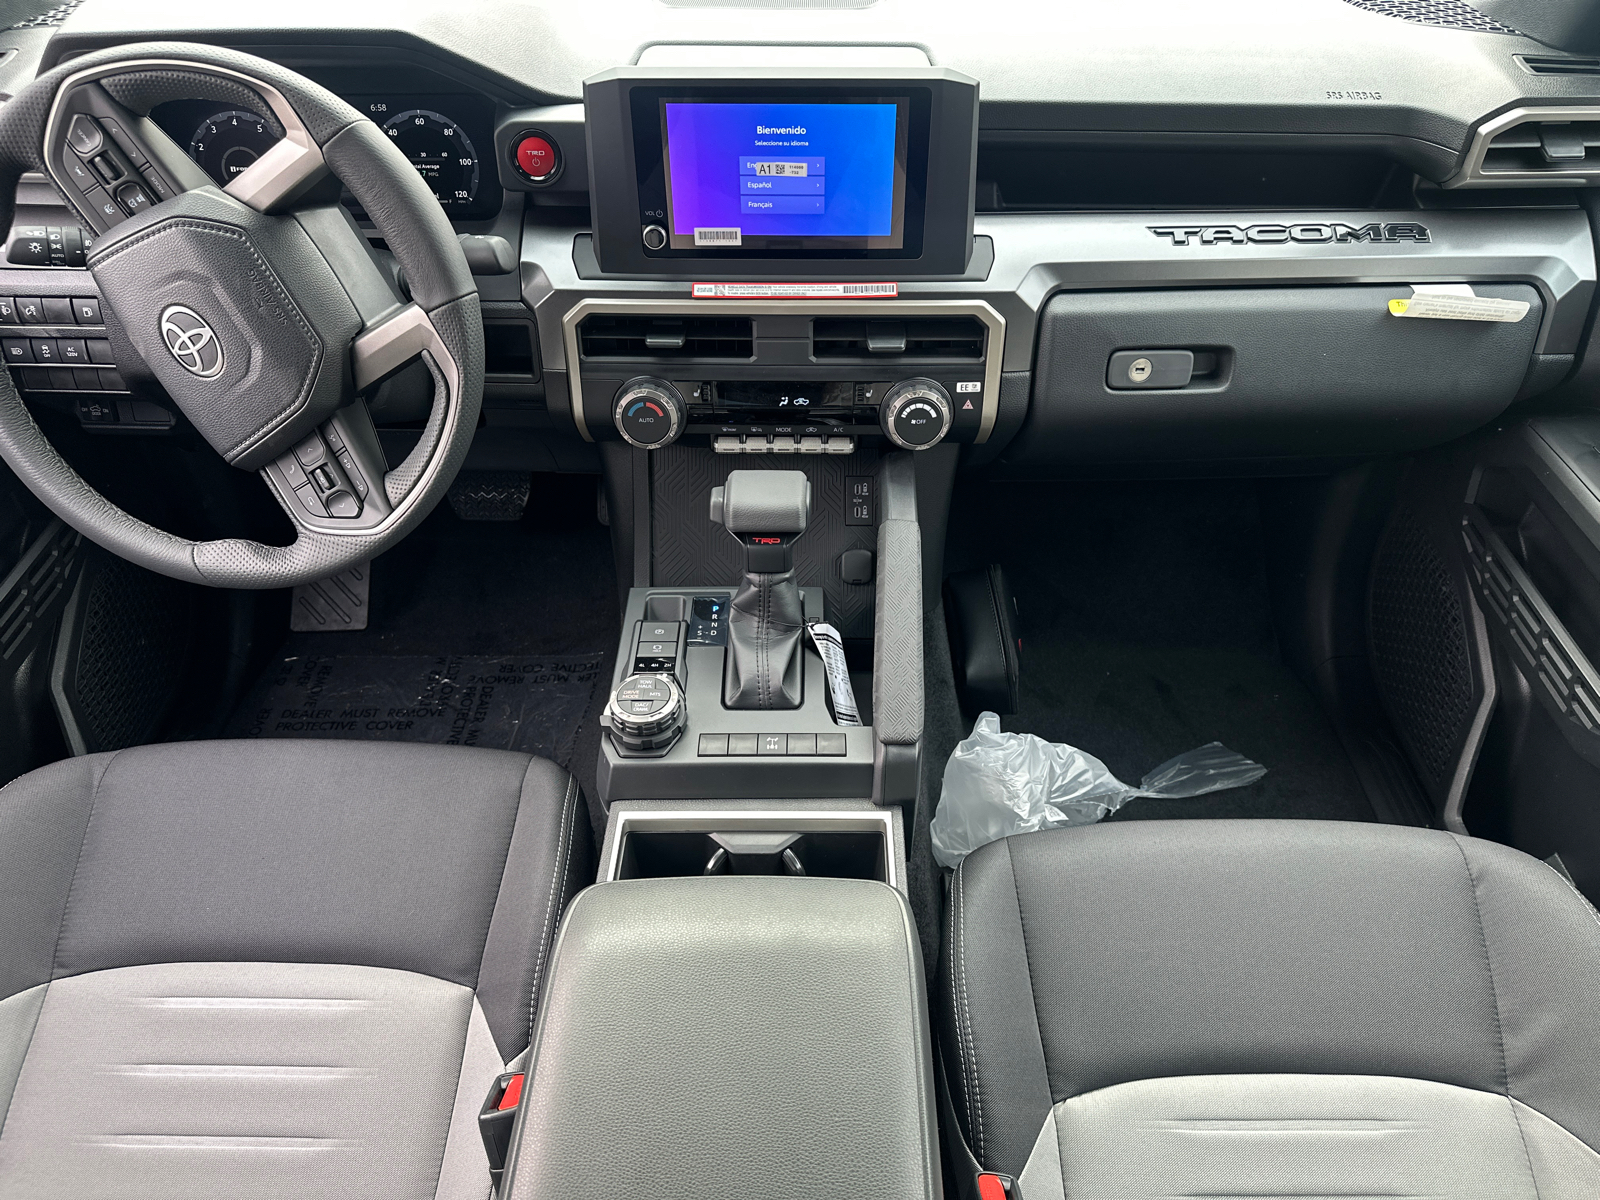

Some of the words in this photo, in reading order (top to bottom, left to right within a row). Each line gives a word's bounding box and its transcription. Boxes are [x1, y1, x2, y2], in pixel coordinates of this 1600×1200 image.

[1326, 91, 1343, 100] SRS
[1346, 91, 1382, 100] AIRBAG
[370, 104, 387, 112] 6:58
[232, 118, 237, 126] 4
[415, 118, 425, 126] 60
[211, 126, 217, 134] 3
[257, 124, 263, 133] 5
[388, 128, 398, 136] 40
[444, 128, 453, 136] 80
[756, 125, 807, 135] Bienvenido
[198, 143, 204, 151] 2
[459, 158, 472, 166] 100
[759, 164, 771, 175] A1
[747, 181, 772, 189] Español
[455, 190, 468, 198] 120
[748, 201, 773, 209] Français
[1145, 222, 1432, 246] TACOMA
[752, 537, 781, 545] TRD
[532, 674, 569, 684] MUST
[471, 685, 494, 723] DEALER
[280, 708, 333, 719] DEALER
[340, 708, 381, 719] MUST
[387, 707, 447, 719] REMOVE
[447, 686, 477, 745] PROTECTIVE
[275, 720, 357, 732] PROTECTIVE
[365, 720, 414, 732] COVER
[464, 729, 482, 746] MU
